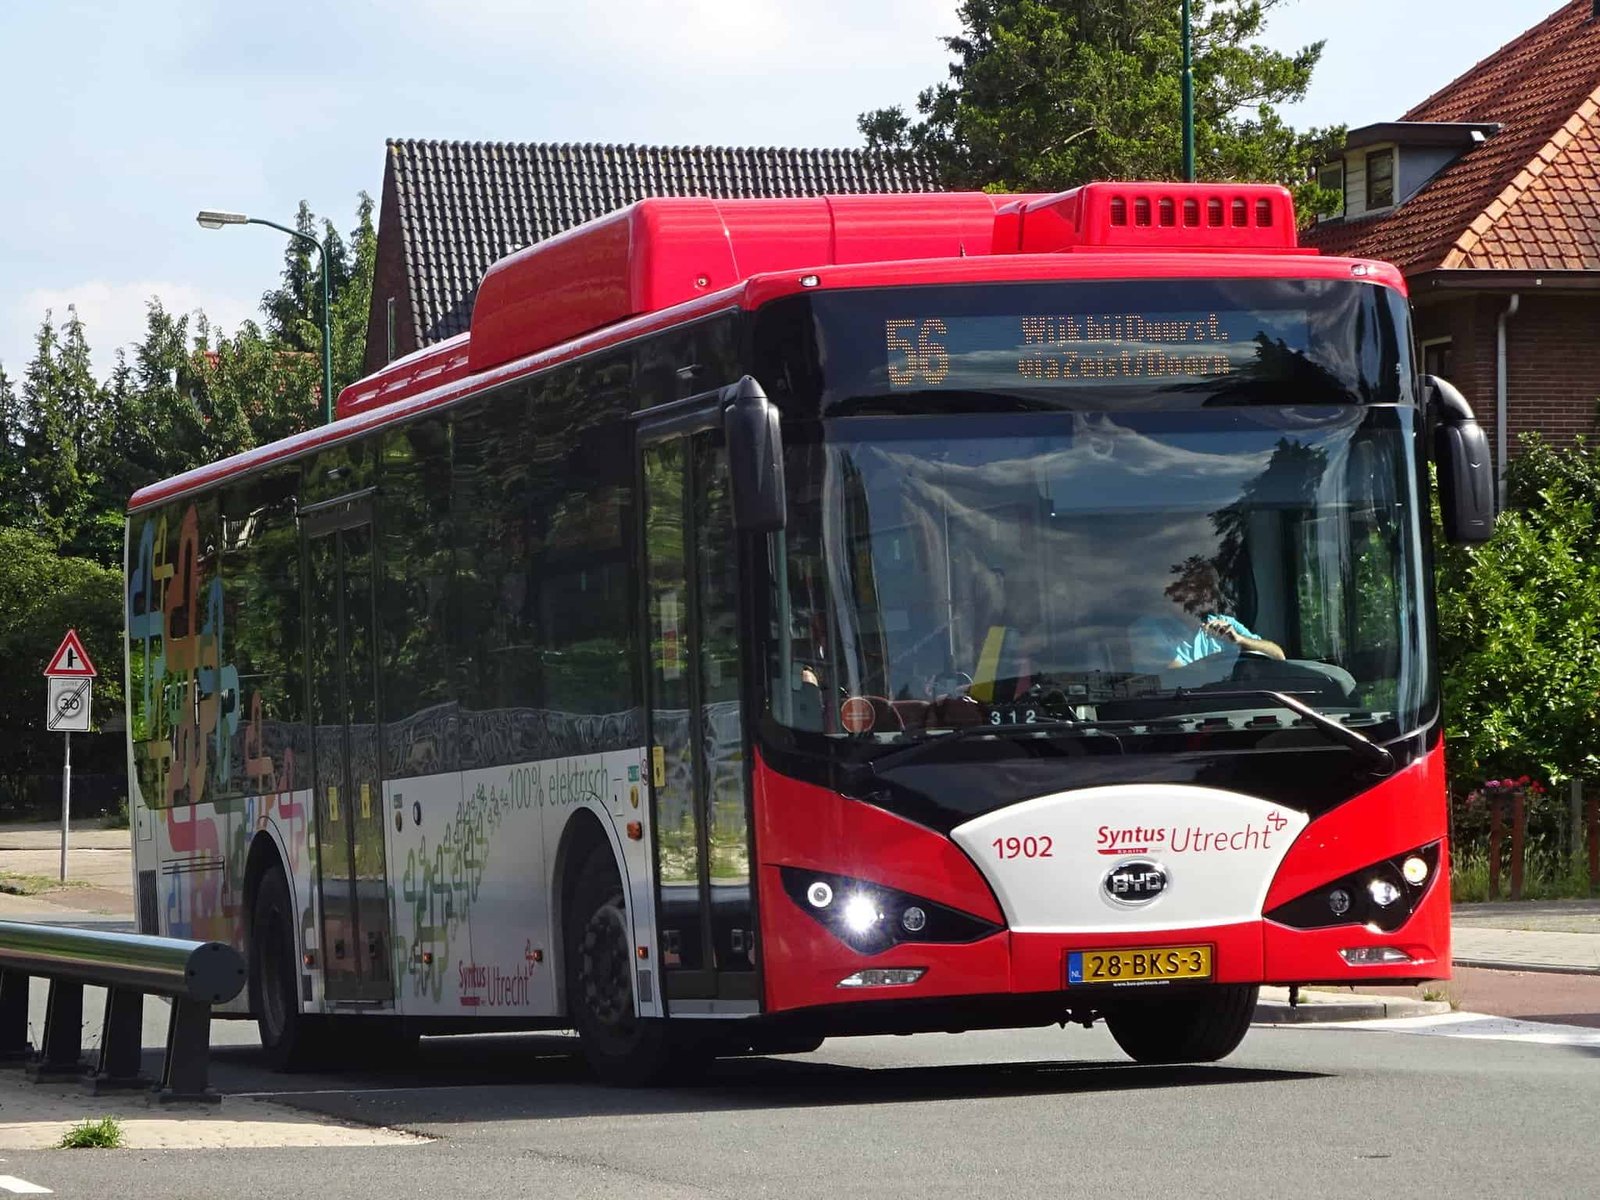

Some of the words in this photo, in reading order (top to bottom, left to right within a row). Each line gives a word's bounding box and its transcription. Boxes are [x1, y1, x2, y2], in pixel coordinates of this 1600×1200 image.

[1022, 315, 1083, 347] Wijk
[1086, 314, 1122, 347] bij
[1125, 313, 1229, 343] Duurst.
[886, 318, 951, 385] 56
[1018, 351, 1059, 379] via
[60, 698, 79, 710] 30
[508, 763, 545, 810] 100%
[549, 755, 609, 807] elektrisch
[992, 835, 1054, 860] 1902
[1097, 825, 1166, 849] Syntus
[1171, 823, 1272, 853] Utrecht
[1111, 873, 1164, 894] BYD
[1071, 970, 1082, 978] NL
[1090, 950, 1203, 978] 28-BKS-3
[458, 959, 486, 996] Syntus
[487, 963, 530, 1007] Utrecht
